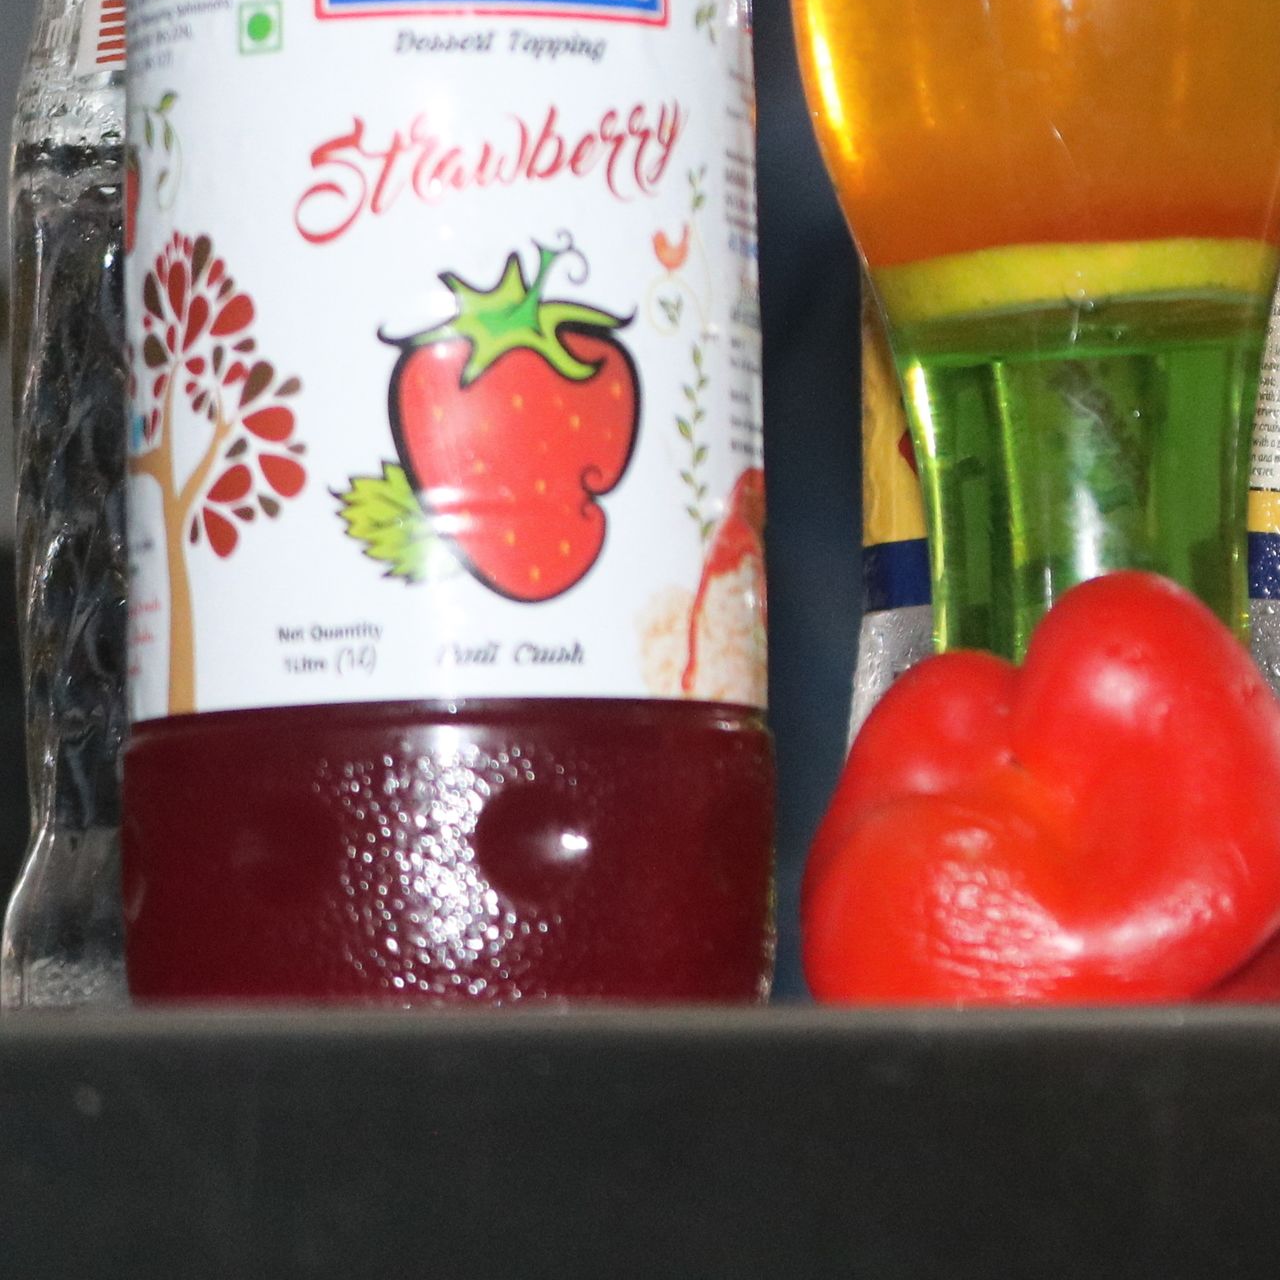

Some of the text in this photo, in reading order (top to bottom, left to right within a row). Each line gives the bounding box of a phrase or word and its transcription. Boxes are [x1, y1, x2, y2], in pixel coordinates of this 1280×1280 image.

[395, 30, 607, 60] Dessert Topping
[295, 97, 688, 247] Strawberry
[512, 635, 585, 665] Crush
